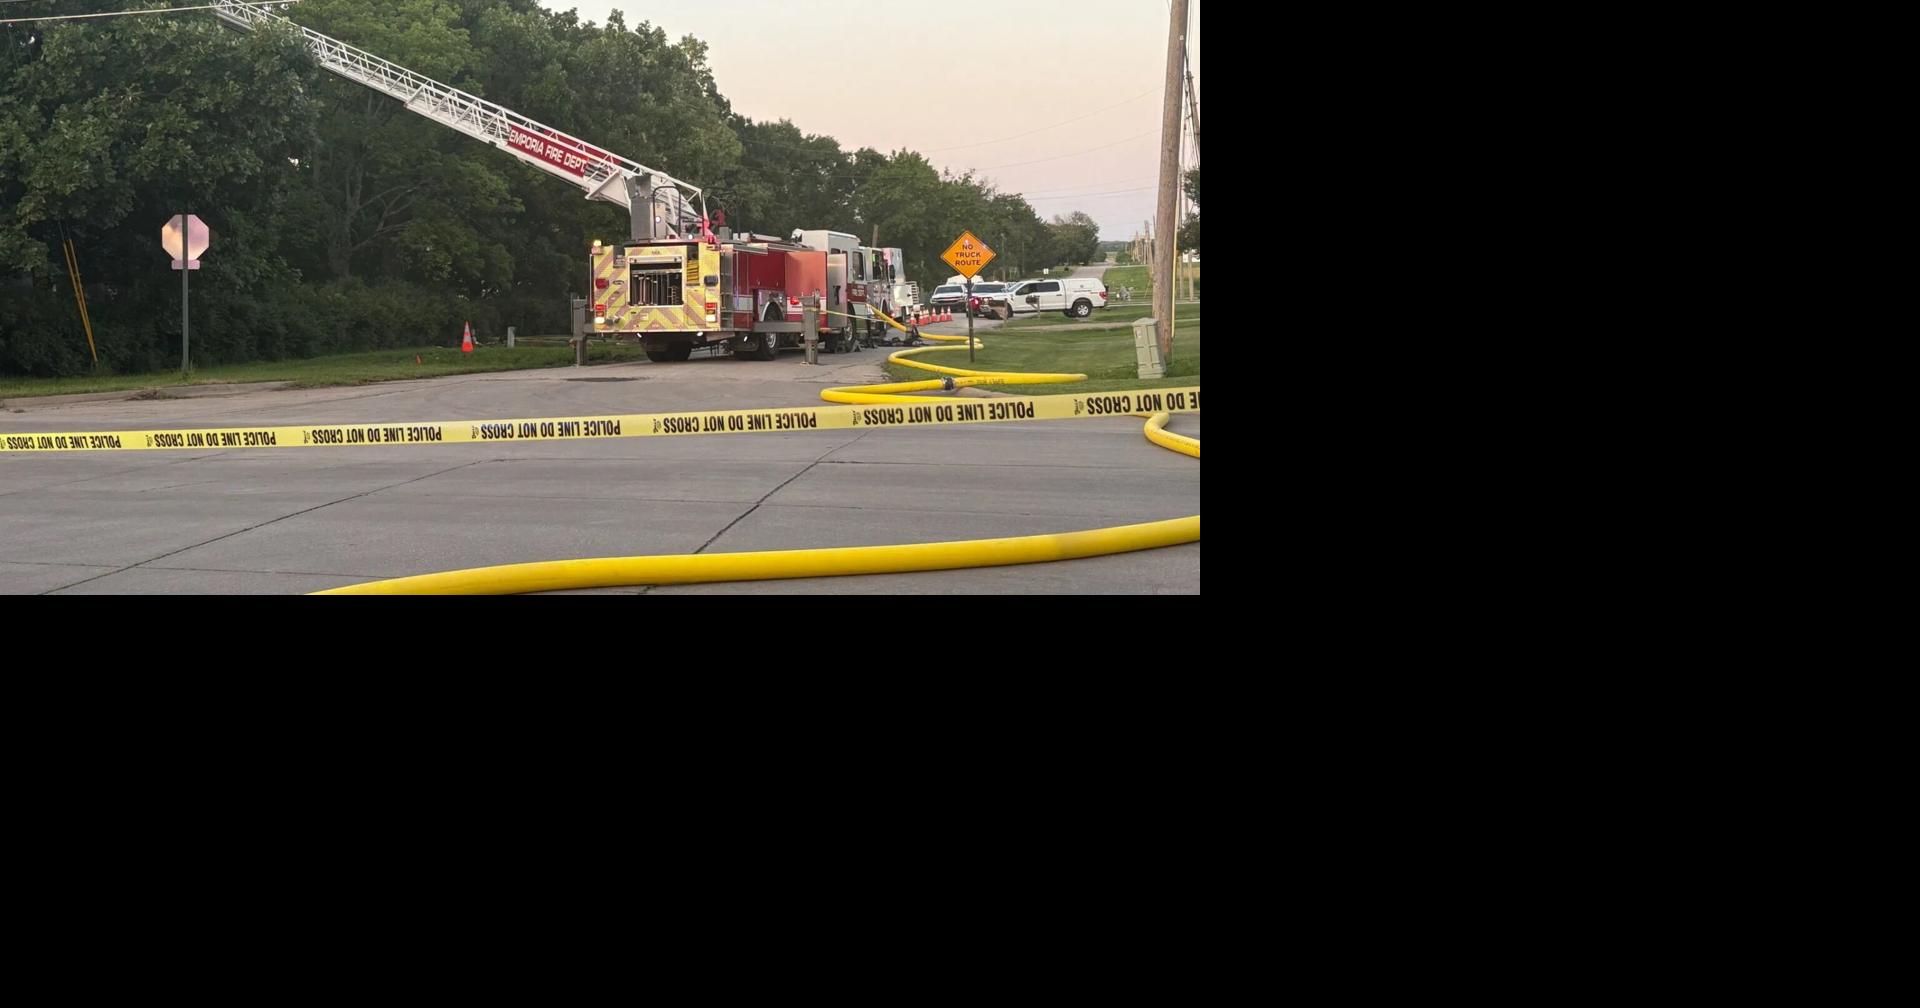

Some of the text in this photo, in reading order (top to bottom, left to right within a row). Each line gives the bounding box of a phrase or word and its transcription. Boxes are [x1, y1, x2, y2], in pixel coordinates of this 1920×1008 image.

[509, 130, 544, 155] EMPORIA
[545, 145, 563, 162] FIRE
[1086, 395, 1132, 415] CROSS
[1135, 394, 1163, 412] NOT
[1166, 392, 1186, 410] DO
[863, 405, 904, 425] CROSS
[907, 407, 933, 423] NOT
[936, 405, 954, 422] DO
[956, 403, 984, 421] LINE
[988, 400, 1035, 419] POLICE
[583, 419, 621, 436] POLICE
[663, 417, 700, 433] CROSS
[703, 417, 725, 431] NOT
[728, 416, 744, 430] DO
[747, 415, 772, 430] LINE
[775, 412, 817, 429] POLICE
[311, 429, 344, 443] CROSS
[346, 429, 365, 443] NOT
[367, 429, 381, 442] DO
[383, 428, 405, 442] LINE
[407, 427, 443, 441] POLICE
[480, 424, 514, 439] CROSS
[517, 423, 538, 438] NOT
[540, 423, 555, 437] DO
[557, 422, 581, 436] LINE
[6, 437, 35, 449] CROSS
[37, 437, 54, 448] NOT
[54, 437, 68, 448] DO
[68, 437, 89, 448] LINE
[90, 436, 122, 448] POLICE
[154, 434, 184, 447] CROSS
[186, 434, 204, 446] NOT
[205, 433, 219, 446] DO
[220, 433, 242, 445] LINE
[243, 432, 277, 445] POLICE
